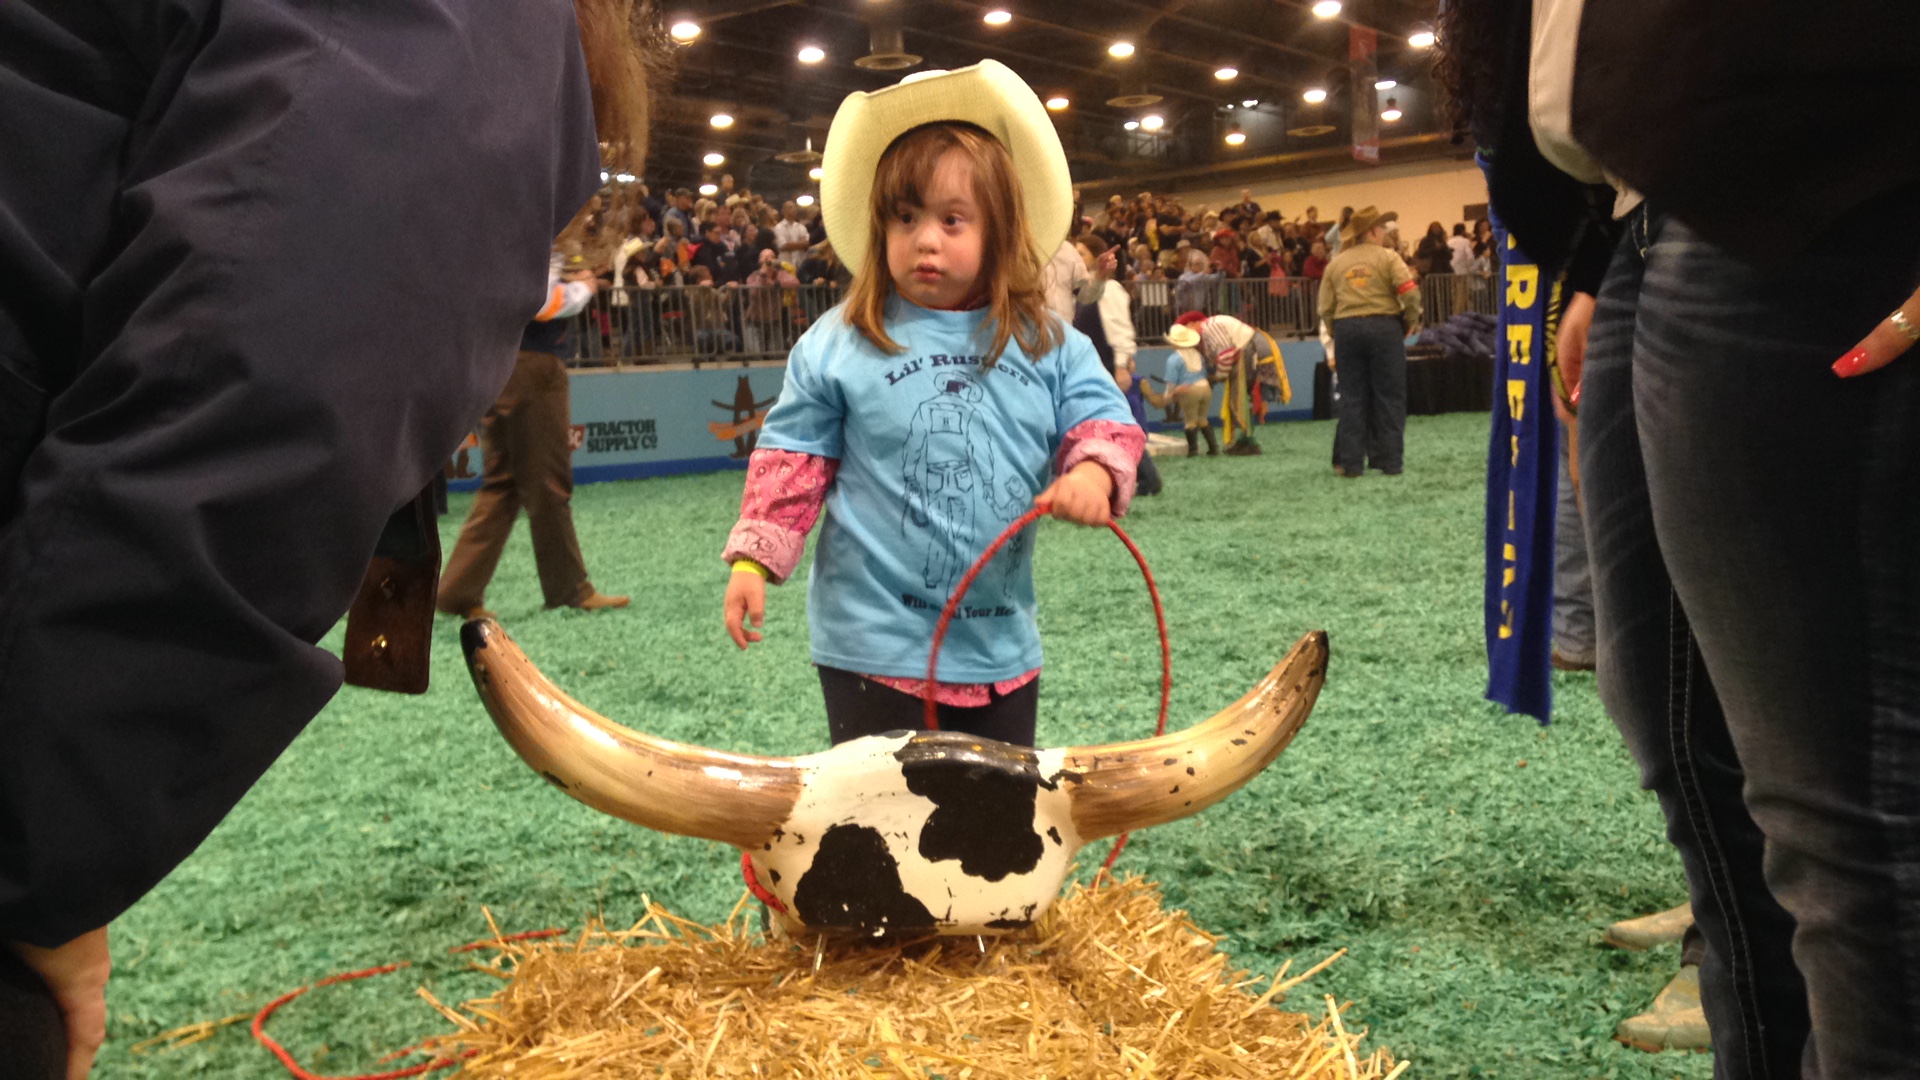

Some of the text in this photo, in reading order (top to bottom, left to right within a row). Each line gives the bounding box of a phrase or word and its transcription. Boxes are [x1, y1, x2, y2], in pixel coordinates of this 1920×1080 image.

[885, 353, 1030, 387] Lil' Rusers
[586, 419, 657, 436] TRACTOR
[587, 436, 639, 453] SUPPLY
[964, 606, 992, 619] Your
